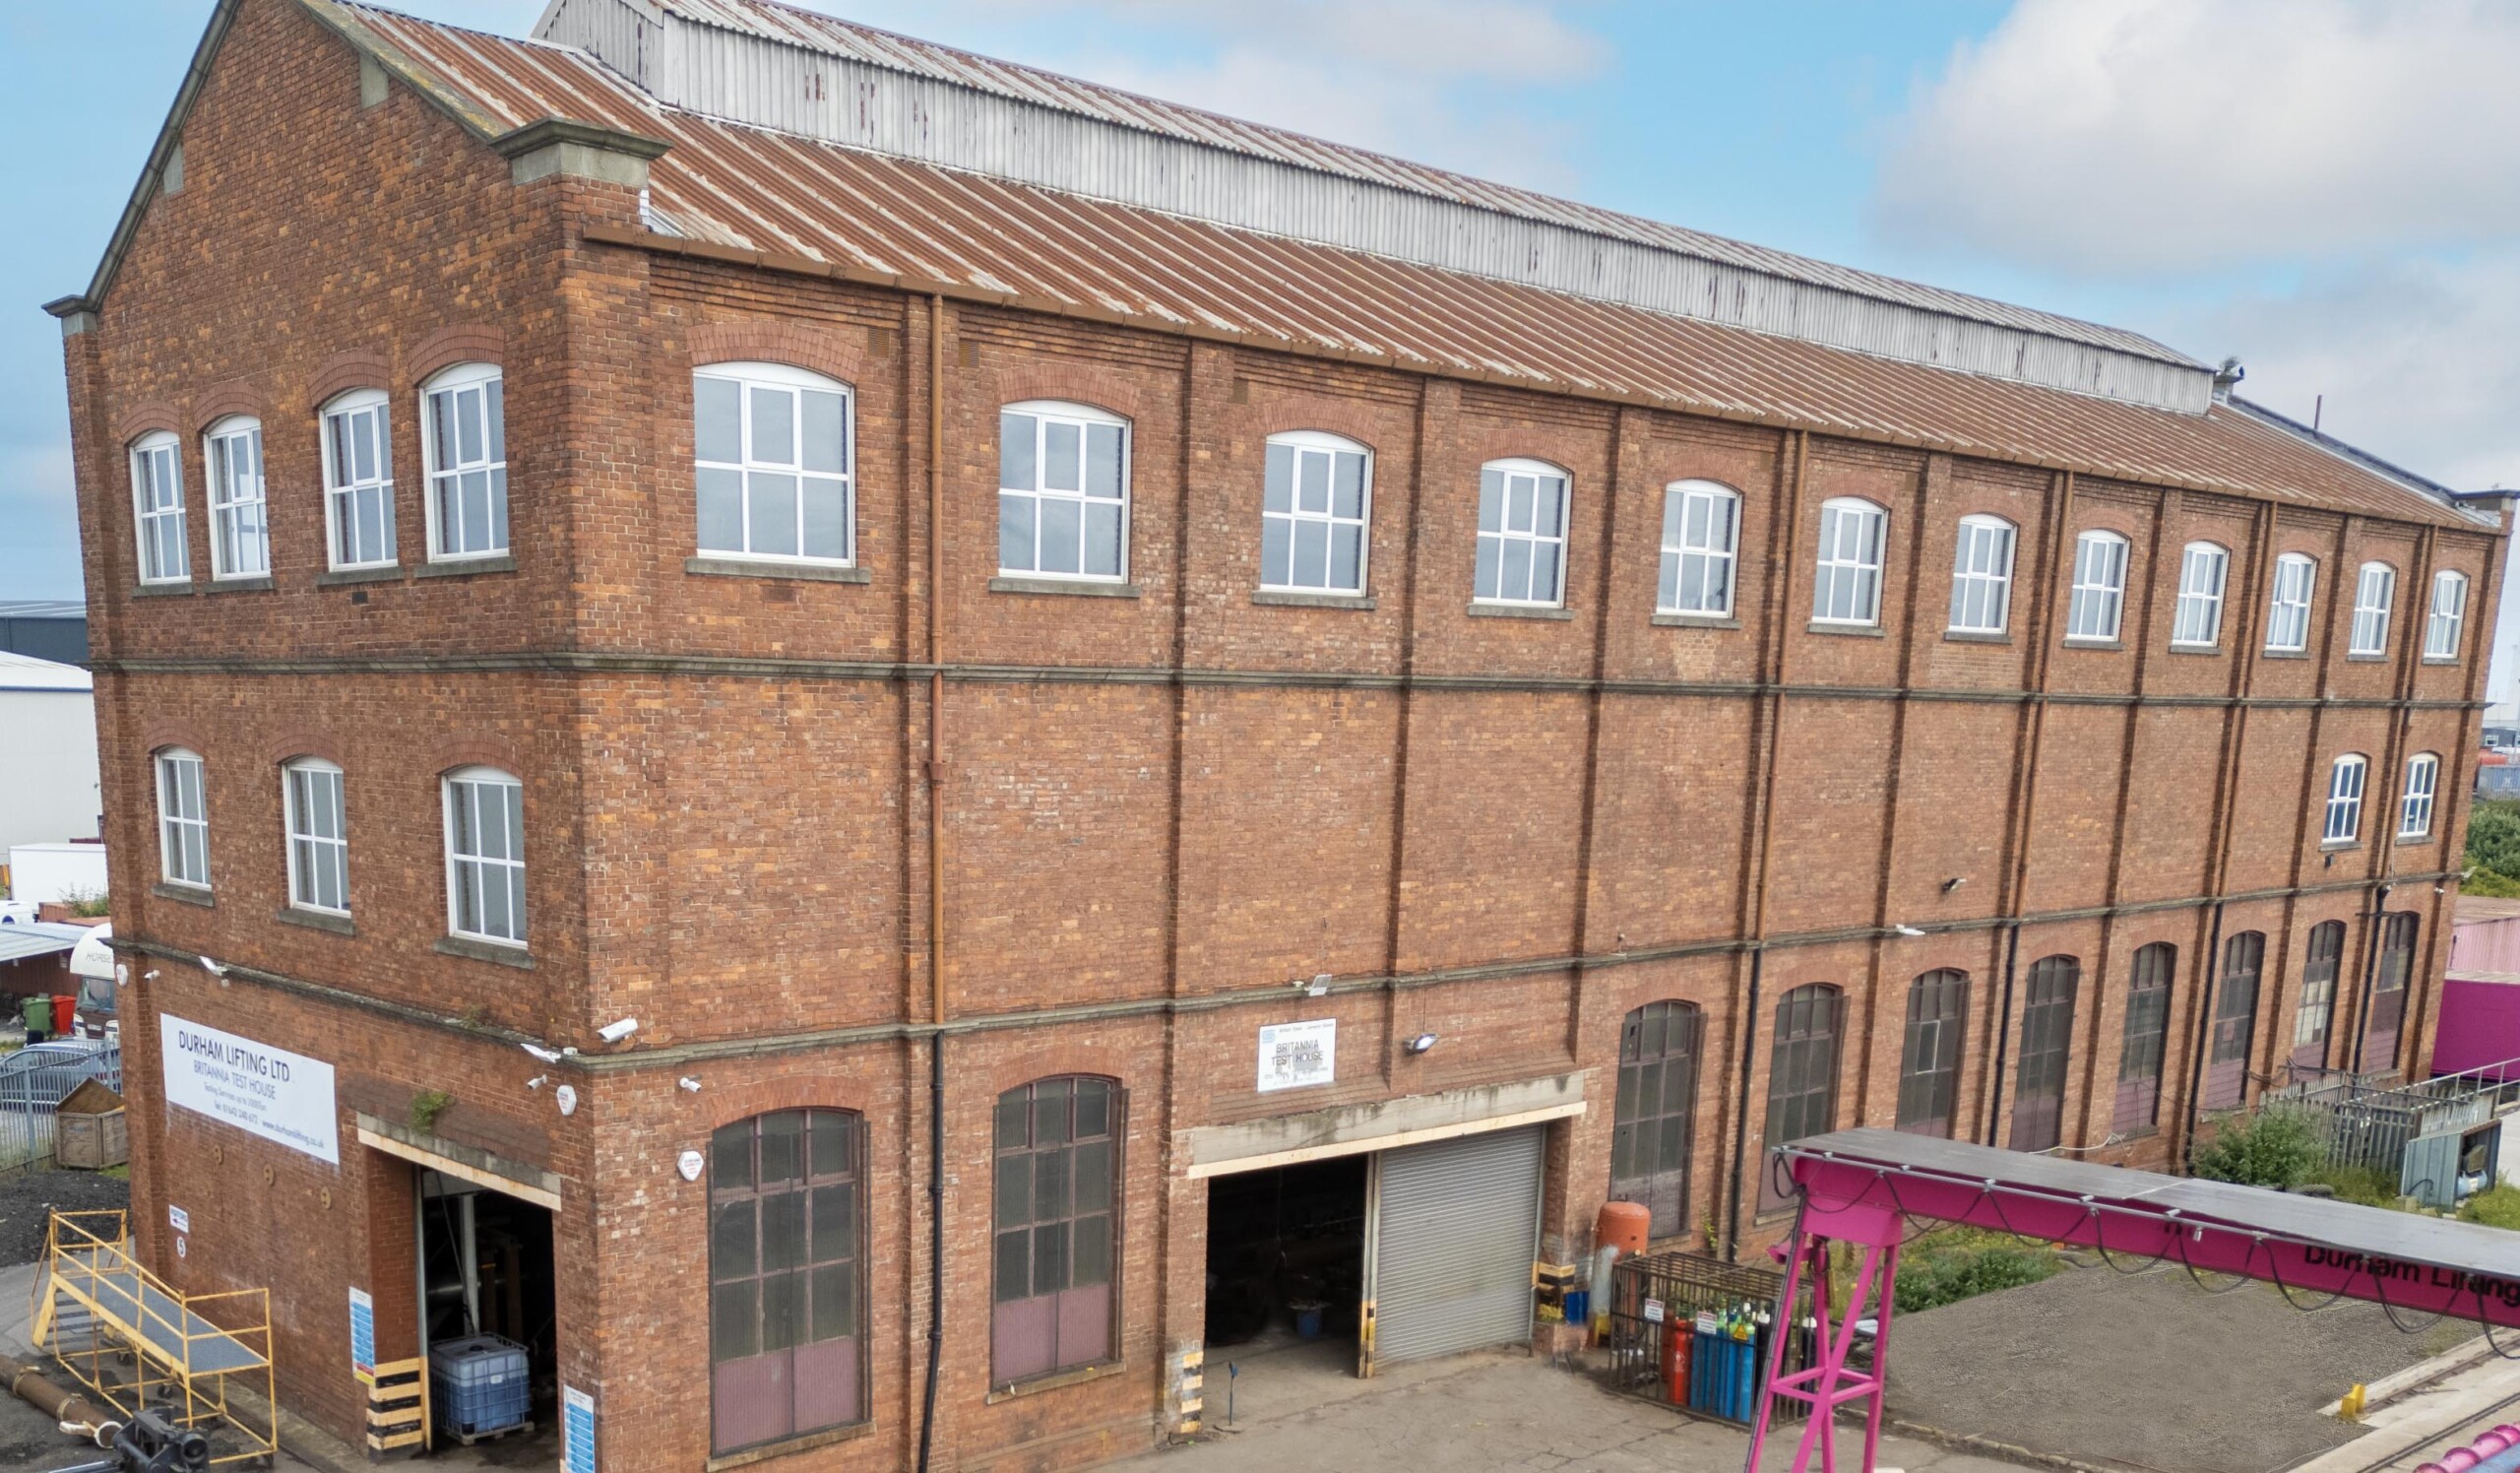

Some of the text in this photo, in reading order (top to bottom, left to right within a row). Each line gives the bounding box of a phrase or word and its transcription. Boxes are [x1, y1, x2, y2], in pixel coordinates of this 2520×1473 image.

[178, 1030, 290, 1082] DURHAM LIFTING LTD
[1271, 1039, 1324, 1067] BRITANNIA TEST HOUSE
[194, 1059, 276, 1100] BRITANNIA TEST HOUSE
